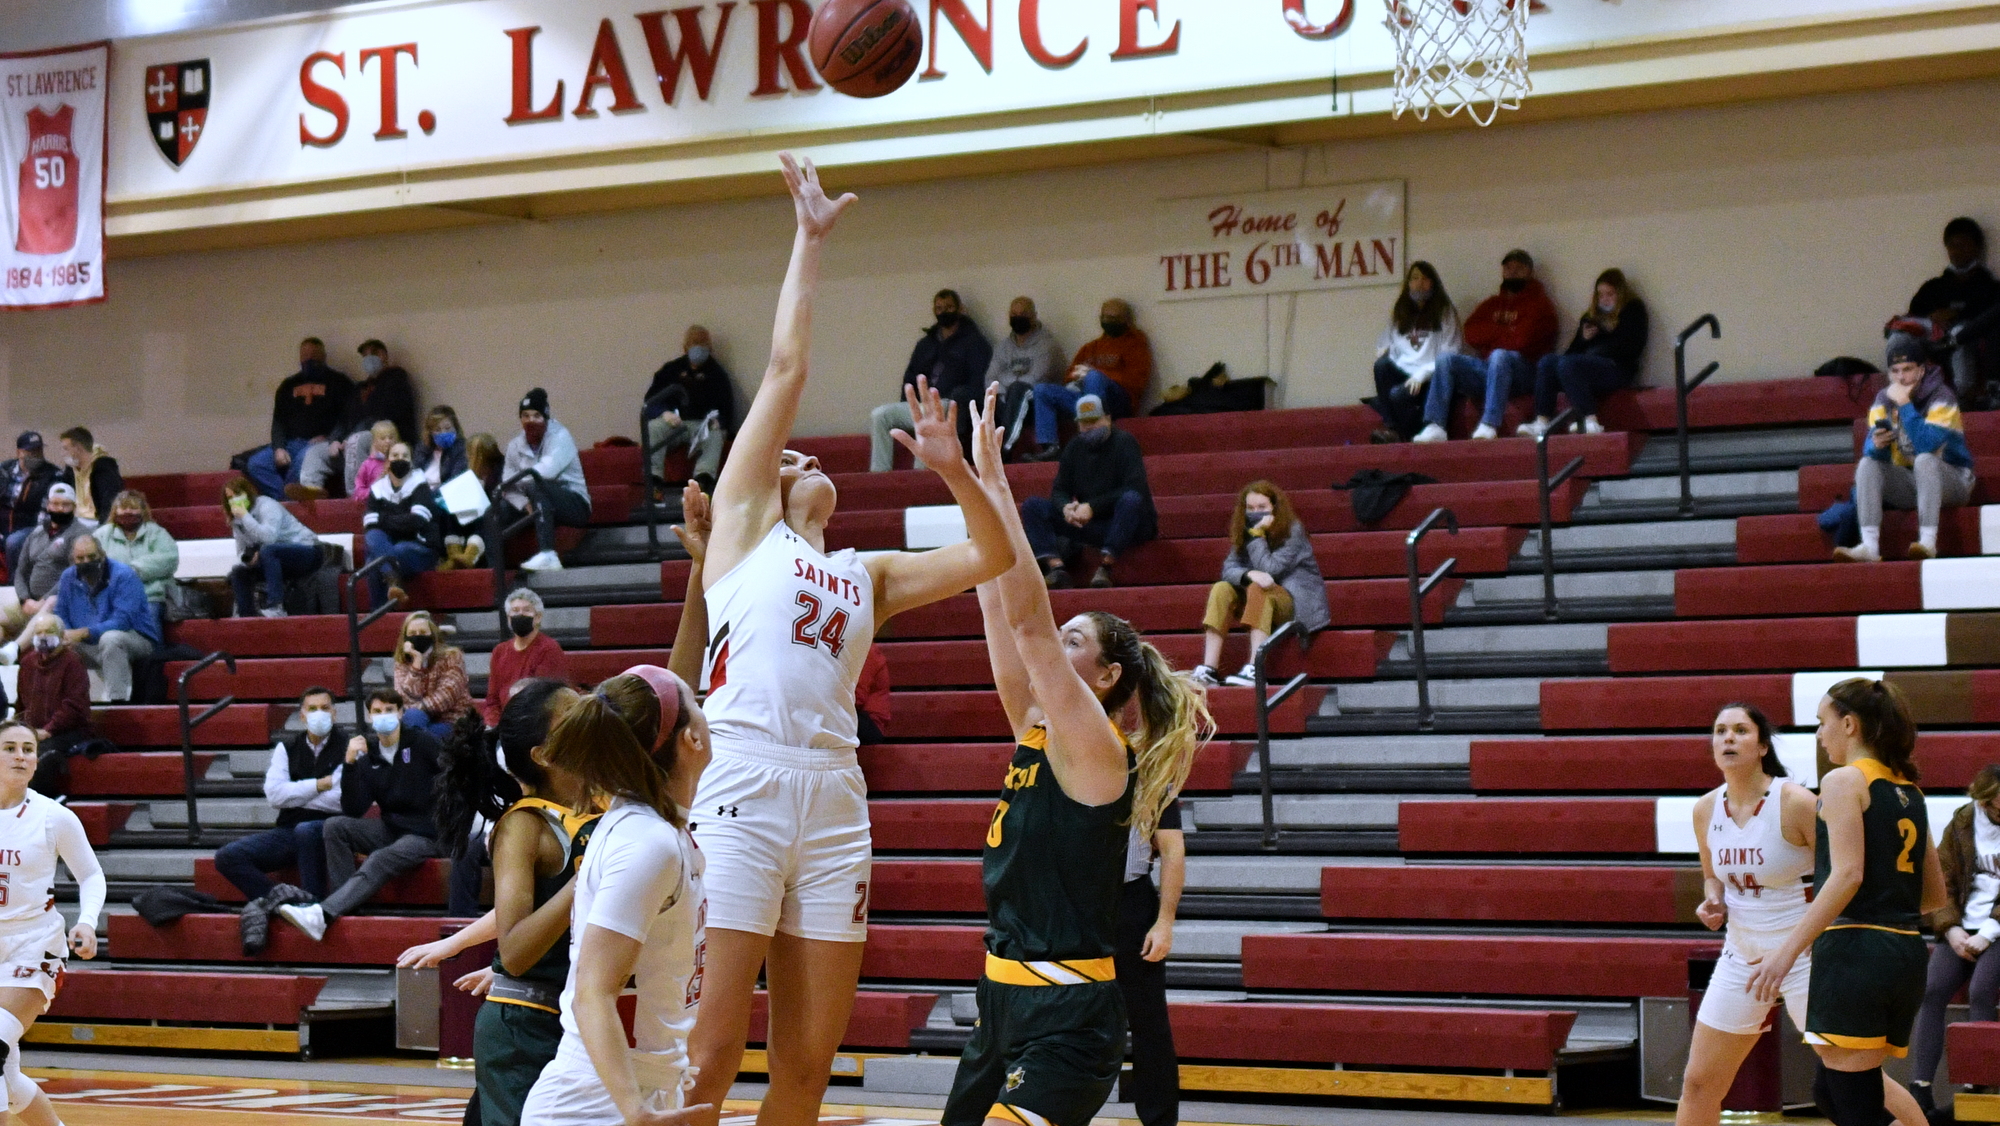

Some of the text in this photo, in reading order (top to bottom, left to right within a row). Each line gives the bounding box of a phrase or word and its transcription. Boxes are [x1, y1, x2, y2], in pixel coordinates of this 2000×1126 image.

[27, 66, 97, 96] LAWRENCE
[299, 0, 1181, 149] ST. LAWRNCE
[32, 133, 69, 155] HARRIS
[35, 156, 65, 189] 50
[1207, 198, 1347, 238] Home of
[1160, 237, 1397, 291] THE 6TH MAN
[794, 558, 861, 607] SAINTS
[791, 590, 851, 658] 24
[1718, 847, 1765, 866] SAINTS
[1897, 818, 1918, 873] 2
[852, 881, 869, 923] 2
[1728, 872, 1764, 898] 14
